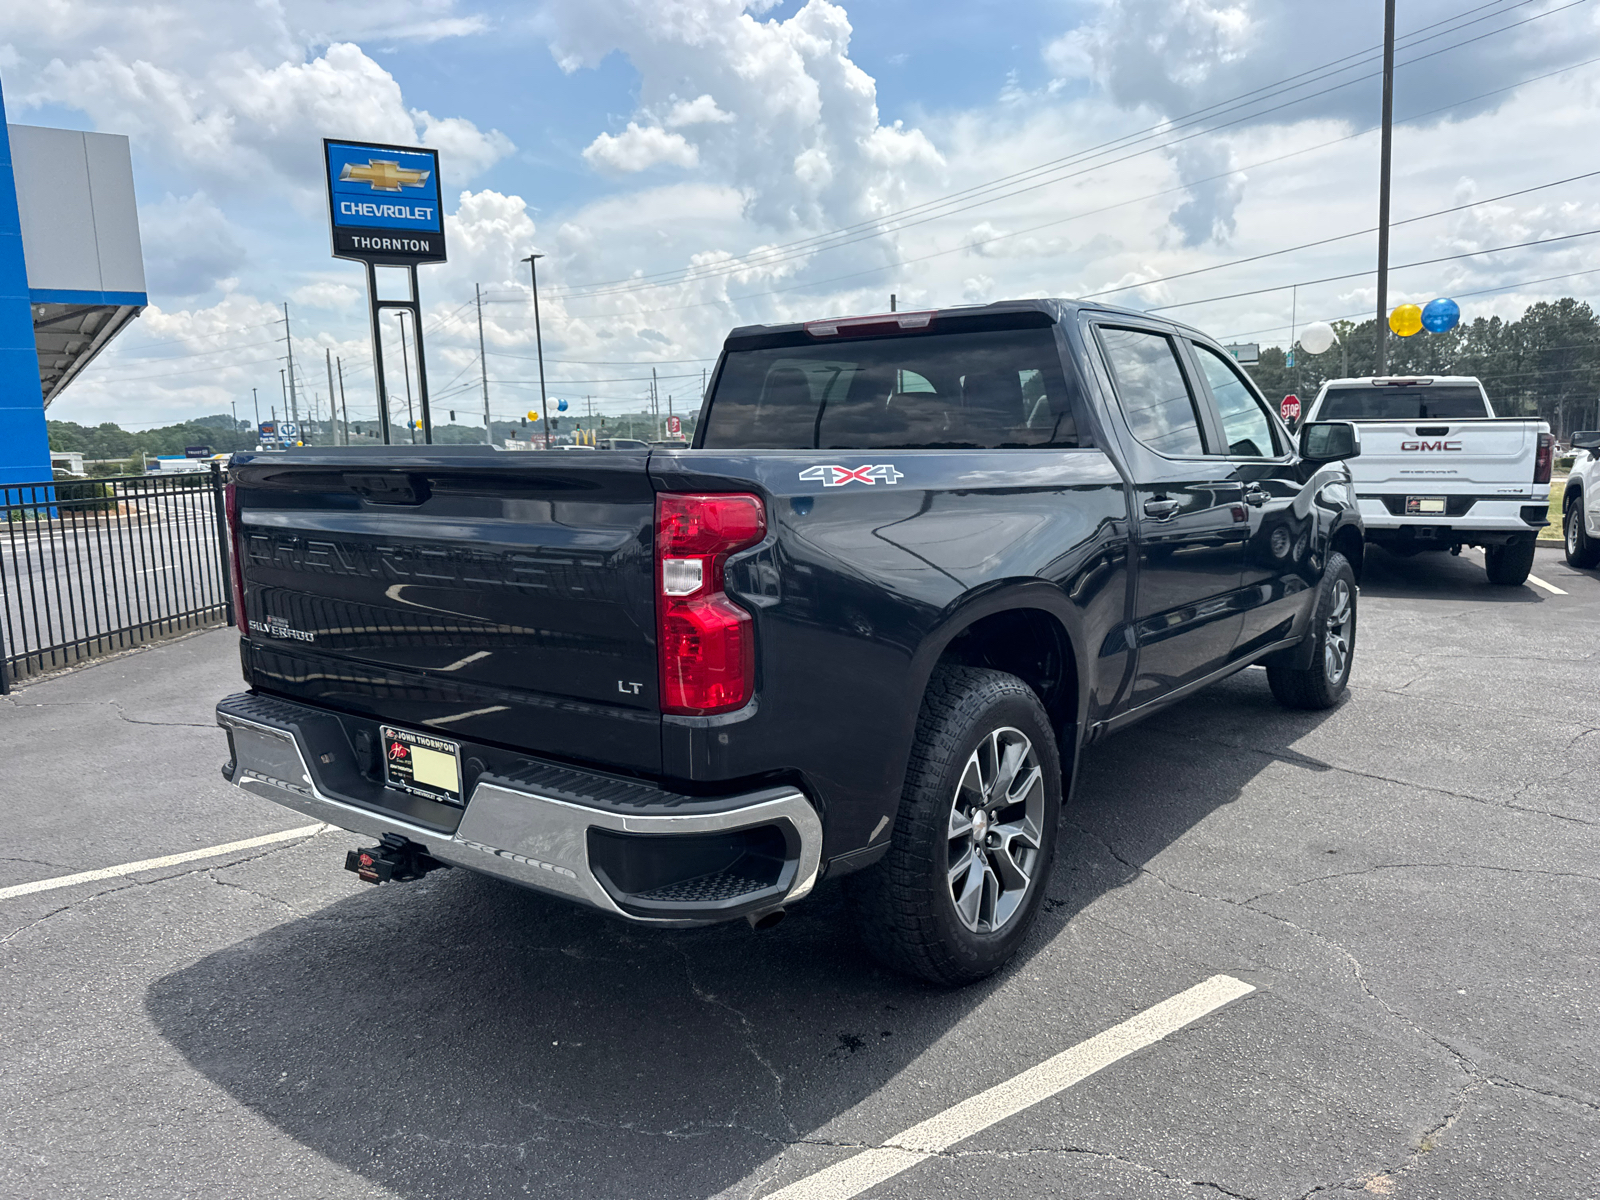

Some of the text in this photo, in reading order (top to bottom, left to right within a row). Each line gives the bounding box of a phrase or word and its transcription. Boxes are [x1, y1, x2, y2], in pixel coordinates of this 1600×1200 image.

[340, 201, 433, 220] CHEVROLET
[352, 236, 430, 252] THORNTON
[1282, 403, 1299, 417] STOP
[1400, 440, 1463, 452] GMC
[248, 620, 315, 643] SILVERADO
[617, 680, 643, 695] LT
[398, 732, 454, 752] JOHN THORNTON
[413, 789, 436, 800] CHEVROLET
